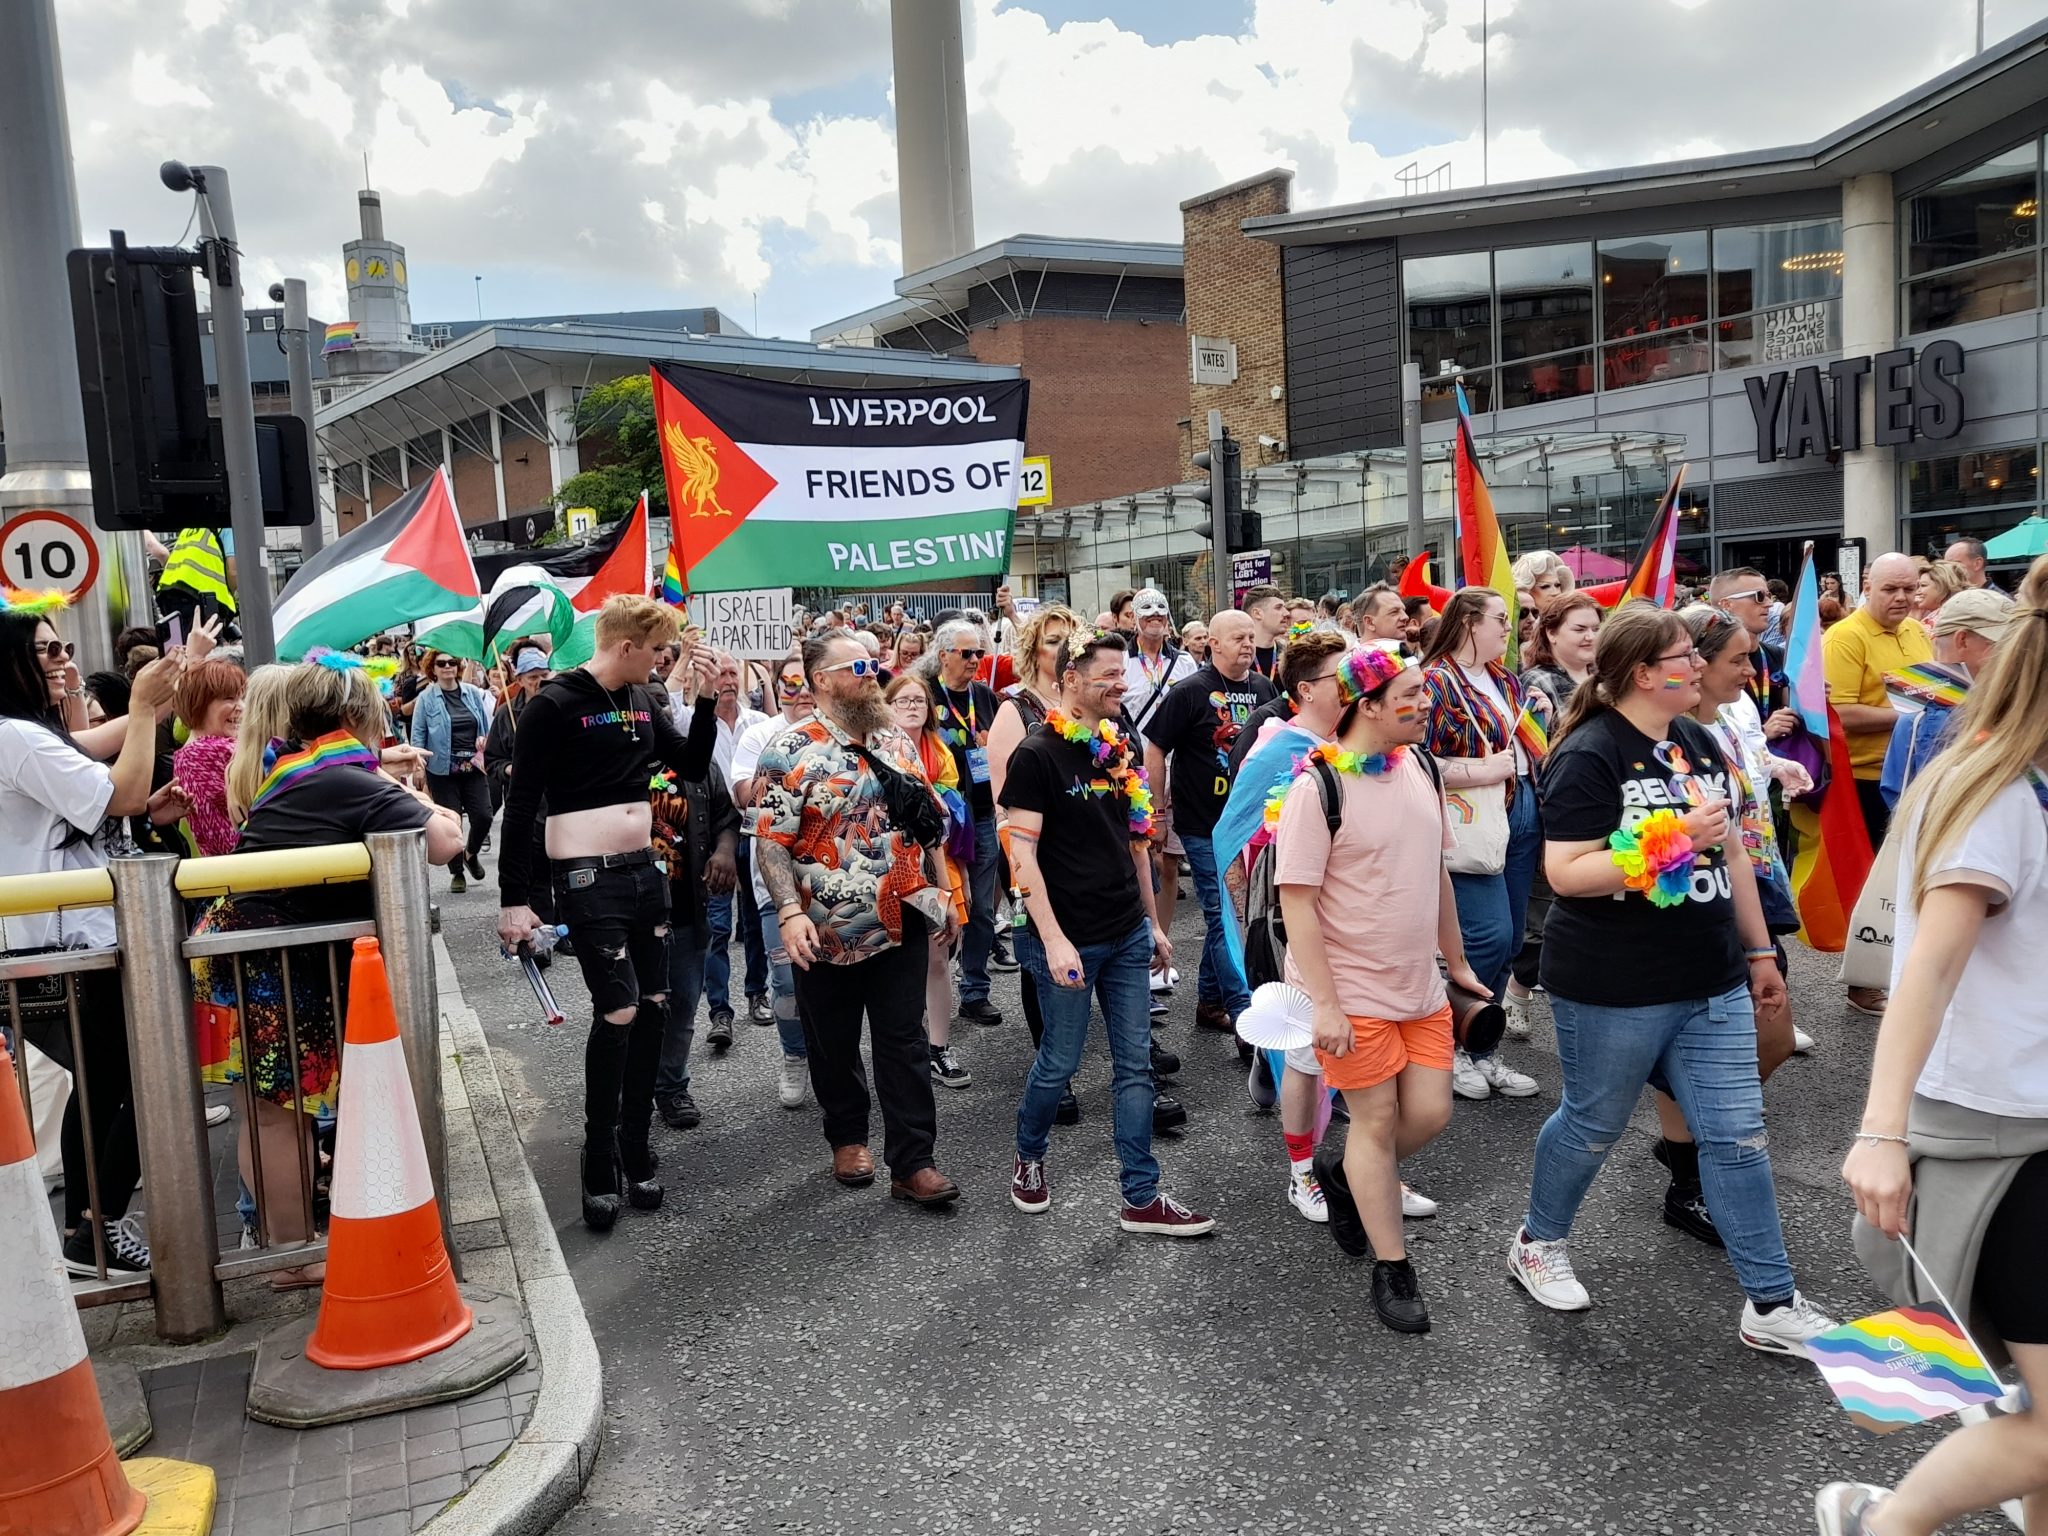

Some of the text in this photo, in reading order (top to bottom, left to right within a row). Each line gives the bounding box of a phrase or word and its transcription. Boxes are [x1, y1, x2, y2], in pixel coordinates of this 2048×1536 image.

[1202, 353, 1225, 367] YATES
[1743, 340, 1964, 463] YATES
[808, 396, 997, 426] LIVERPOOL
[806, 460, 1011, 498] FRIENDS OF
[1020, 470, 1043, 491] 12
[575, 517, 587, 531] 11
[15, 541, 75, 579] 10
[1234, 559, 1266, 571] Fight for
[1234, 569, 1259, 579] LGBT+
[1235, 577, 1268, 588] liberation
[711, 595, 786, 622] ISRAELI
[710, 624, 792, 650] APARTHEID
[1224, 692, 1257, 704] SORRY
[580, 710, 651, 728] TROUBLEMAKE
[1887, 1353, 1926, 1371] STUDENTS
[1909, 1361, 1932, 1374] UNITE
